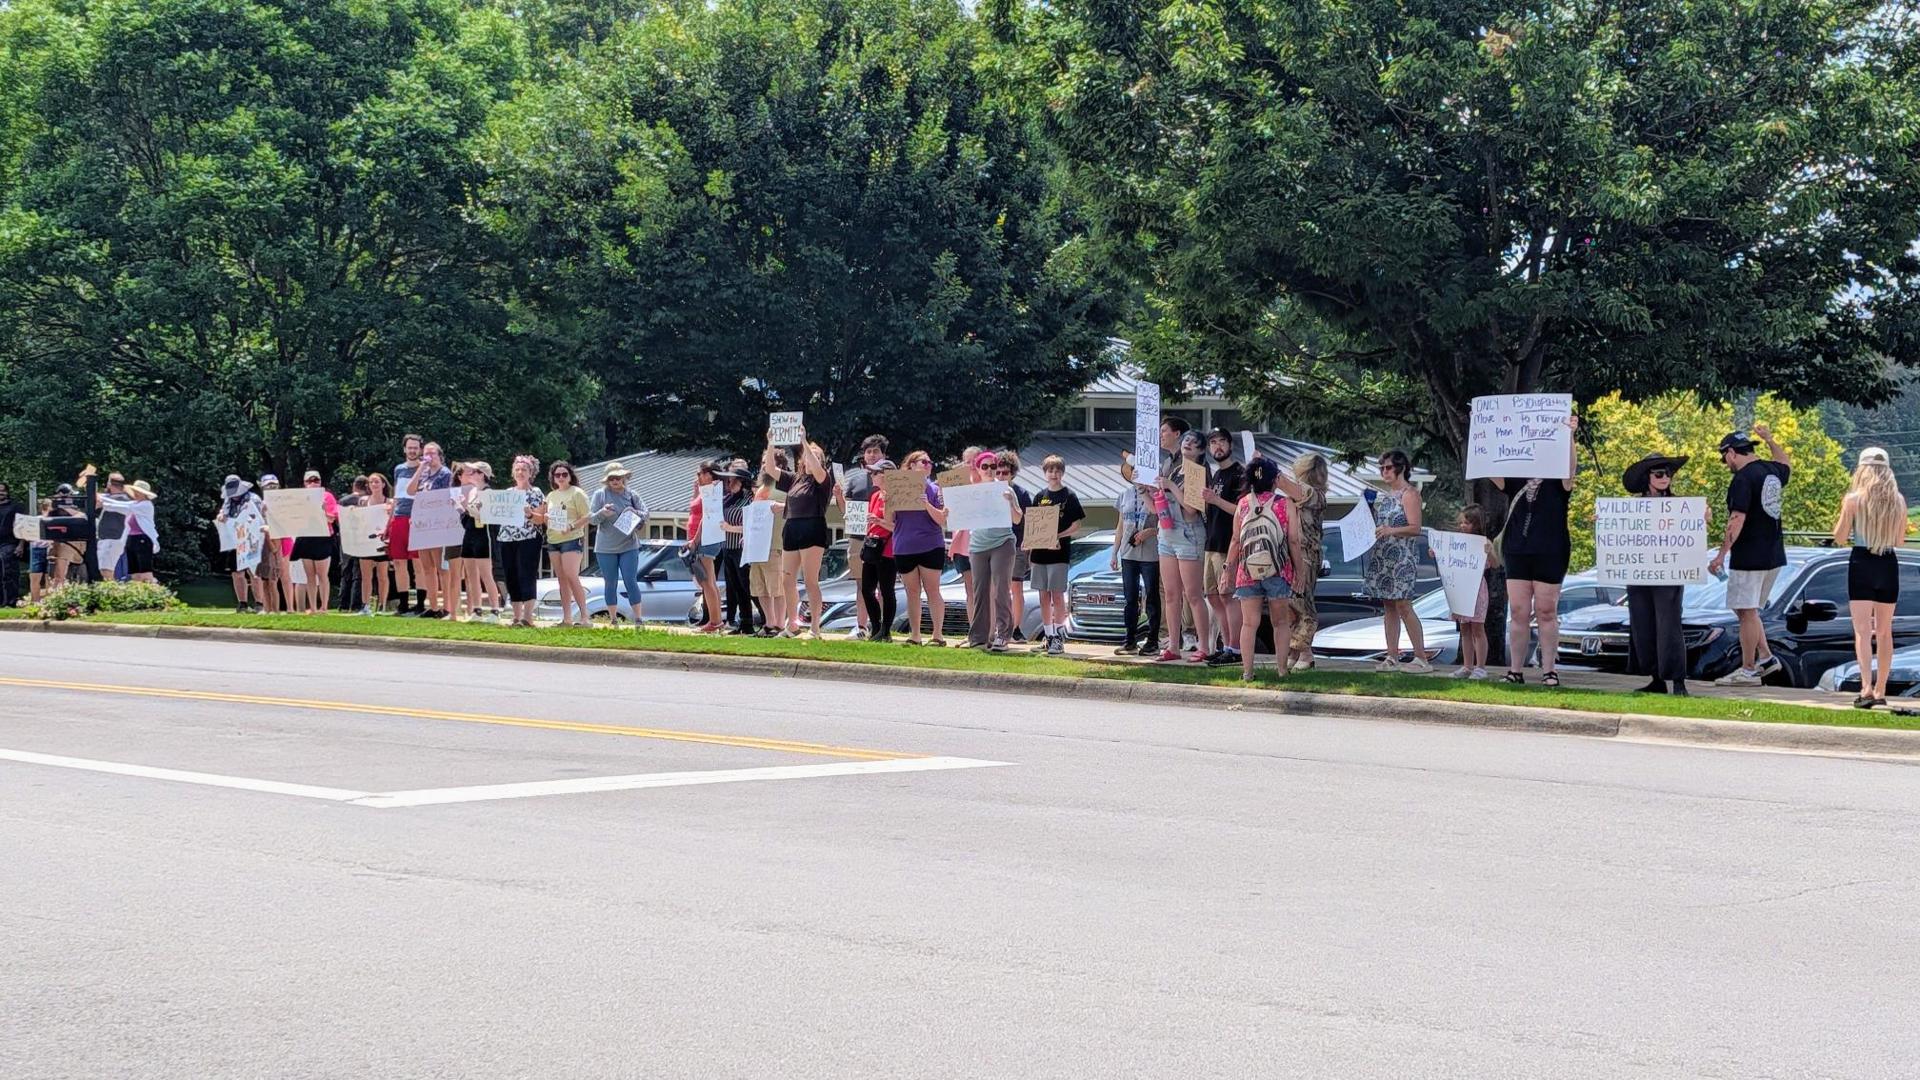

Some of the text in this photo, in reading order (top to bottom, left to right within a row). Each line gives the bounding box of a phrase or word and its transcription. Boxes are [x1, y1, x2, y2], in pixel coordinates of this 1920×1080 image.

[1476, 398, 1500, 412] ONLY
[847, 502, 865, 513] SAVE
[1598, 500, 1691, 514] WILDLIFE IS A
[1597, 518, 1704, 531] FEATURE OF OUR
[1597, 534, 1695, 547] NEIGHBORHOOD
[1606, 553, 1680, 565] PLEASE LET
[1605, 567, 1700, 580] THE GEESE LIVE!
[1086, 593, 1116, 605] GMC
